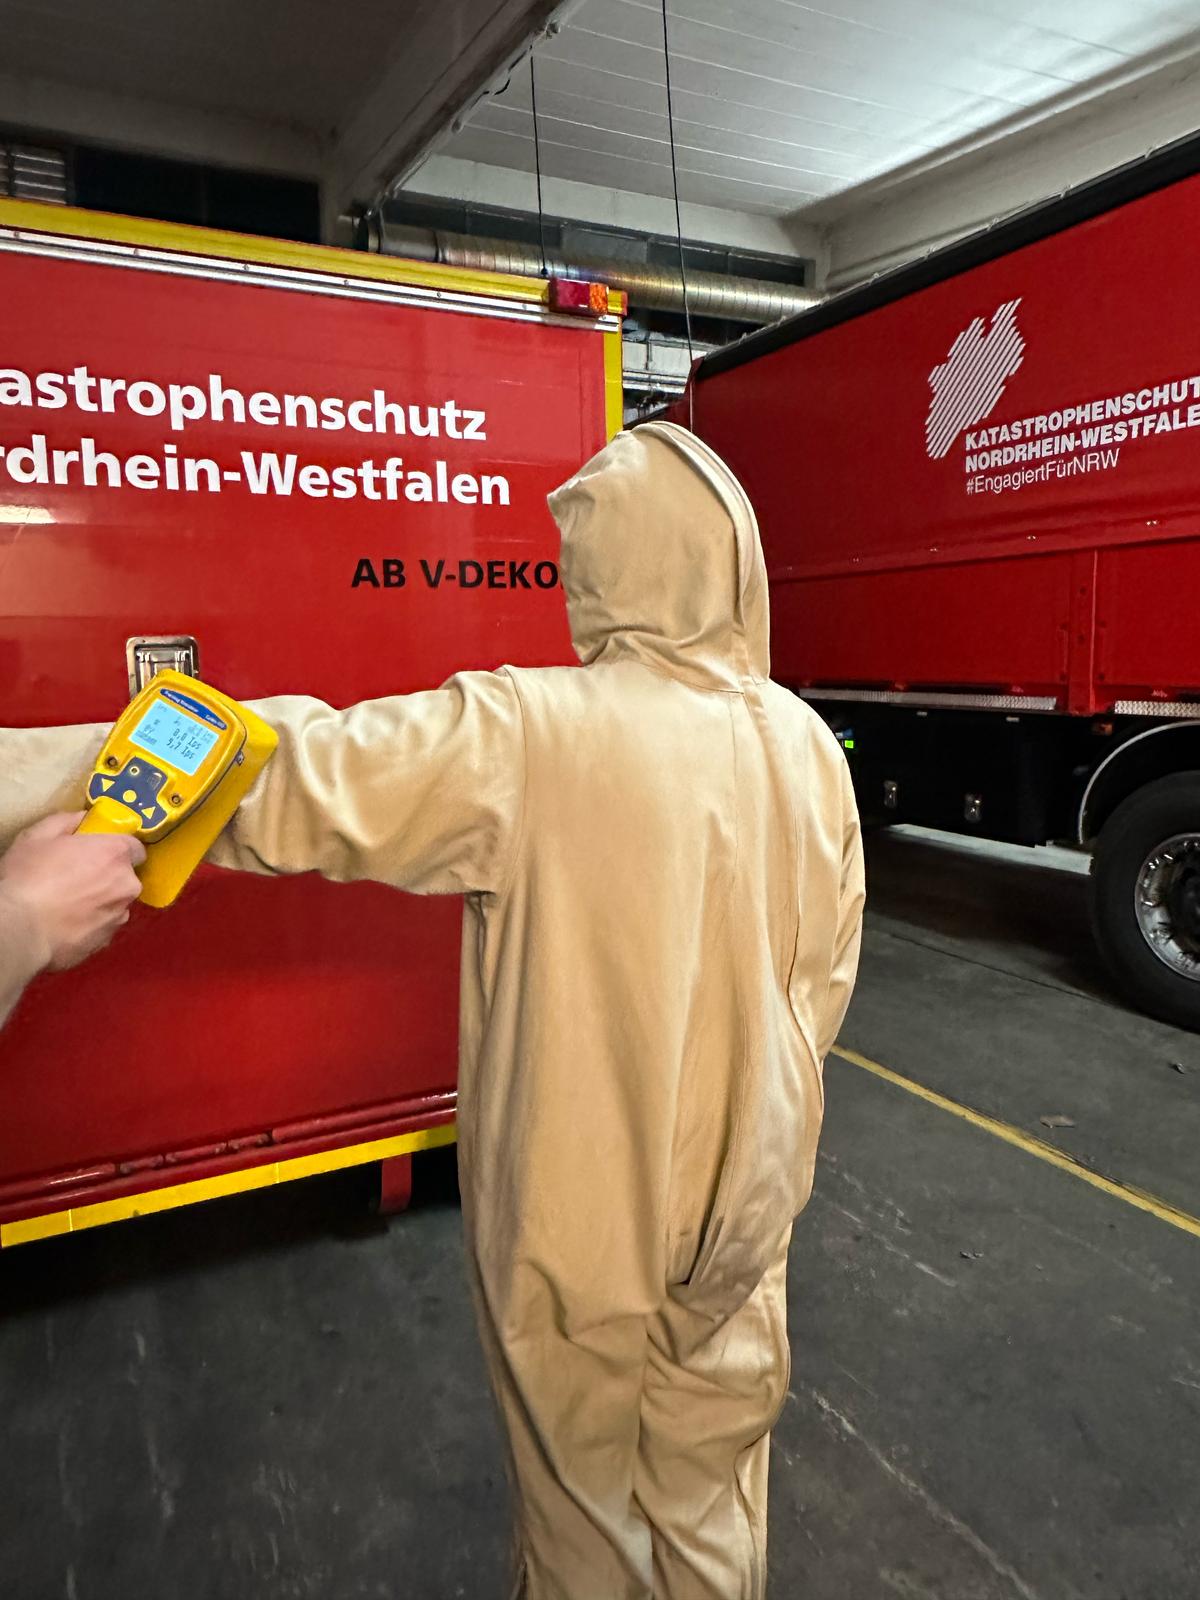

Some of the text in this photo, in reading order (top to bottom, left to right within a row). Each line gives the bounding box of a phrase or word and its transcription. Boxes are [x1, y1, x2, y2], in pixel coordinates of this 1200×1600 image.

[965, 403, 1200, 473] NORDRHEIN-WESTFALE
[0, 434, 510, 506] drhein-Westfalen
[966, 448, 1120, 495] #EngagiertFürNRW
[351, 558, 563, 590] AB V-DEKO
